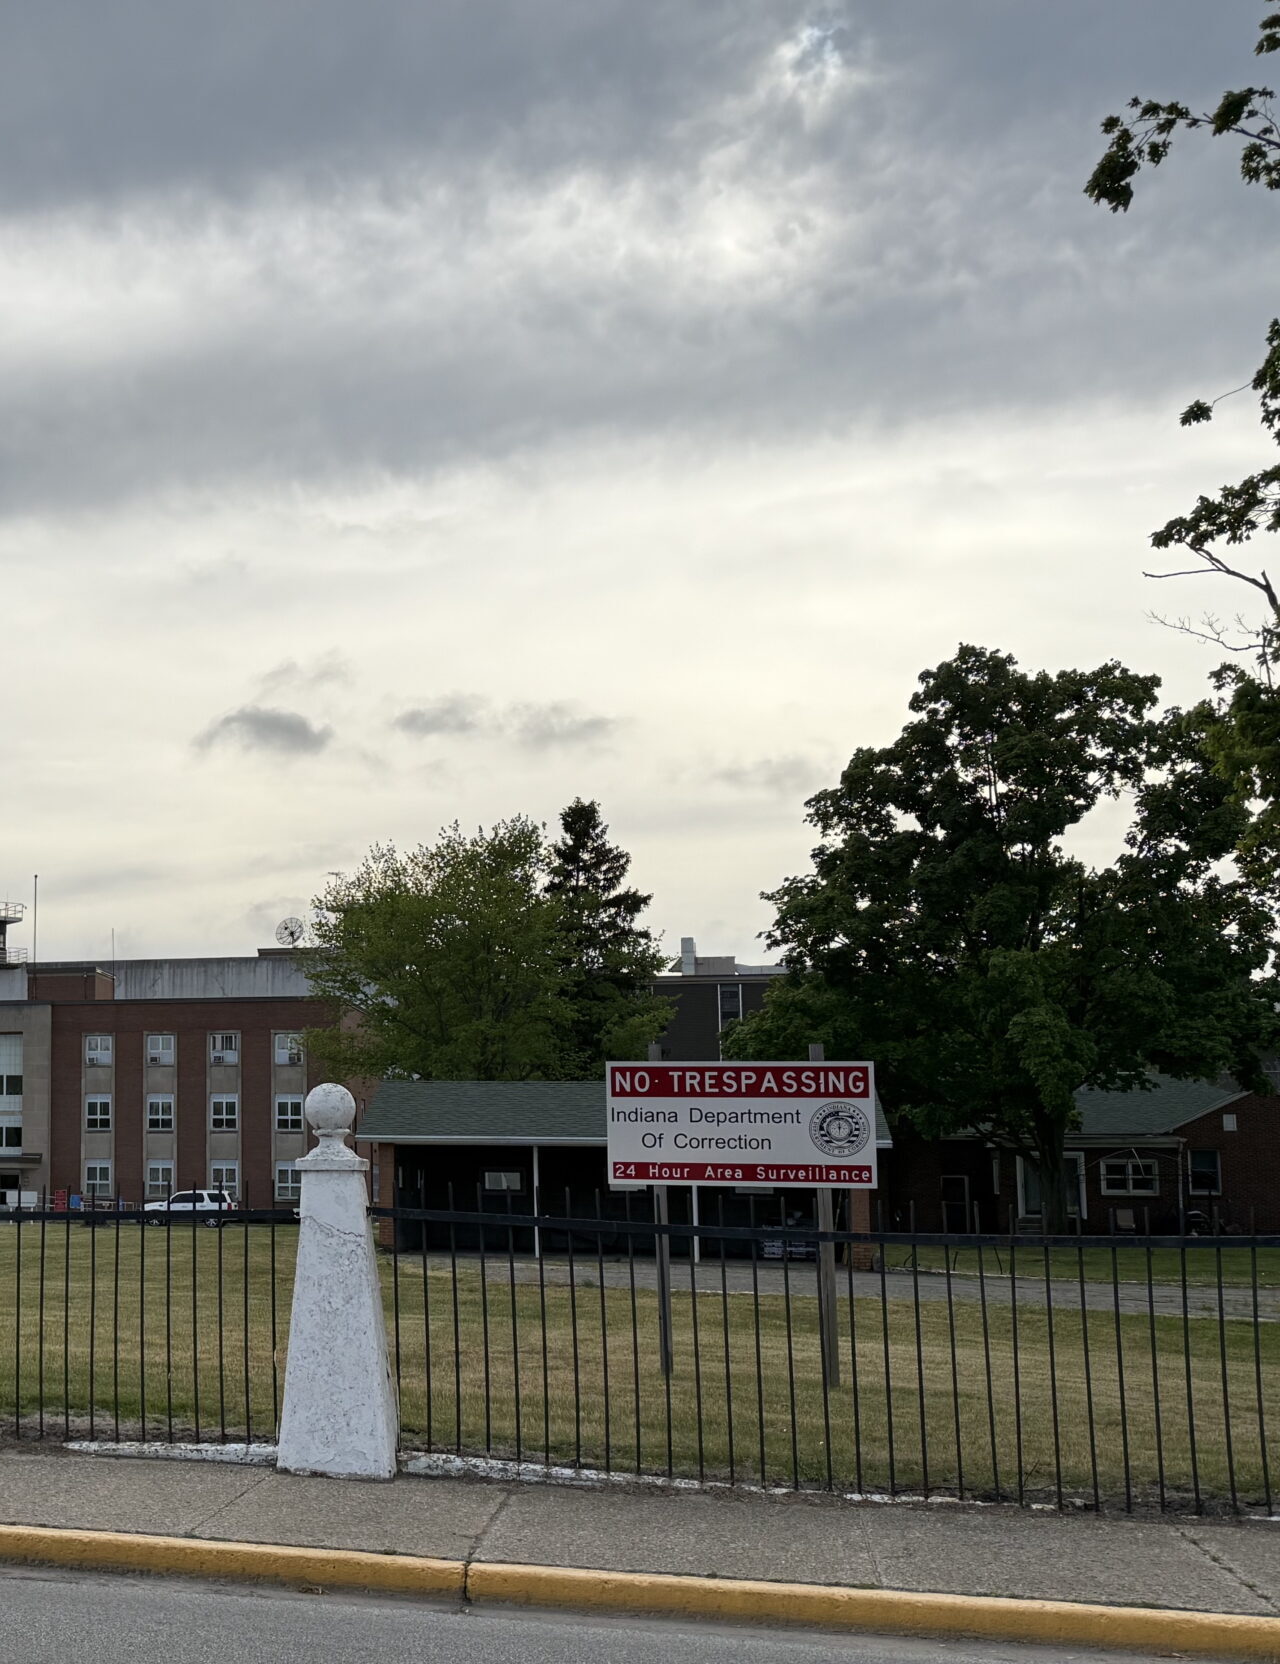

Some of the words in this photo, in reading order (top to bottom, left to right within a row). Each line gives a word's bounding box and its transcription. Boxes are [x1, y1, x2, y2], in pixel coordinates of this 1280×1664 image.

[615, 1071, 650, 1093] NO
[669, 1071, 865, 1094] TRESPASSING
[610, 1107, 678, 1123] Indiana
[689, 1107, 802, 1127] Department
[641, 1132, 664, 1148] Of
[673, 1133, 772, 1150] Correction
[615, 1164, 636, 1177] 24
[649, 1163, 690, 1178] Hour
[704, 1166, 743, 1179] Area
[756, 1165, 870, 1182] Surveillance
